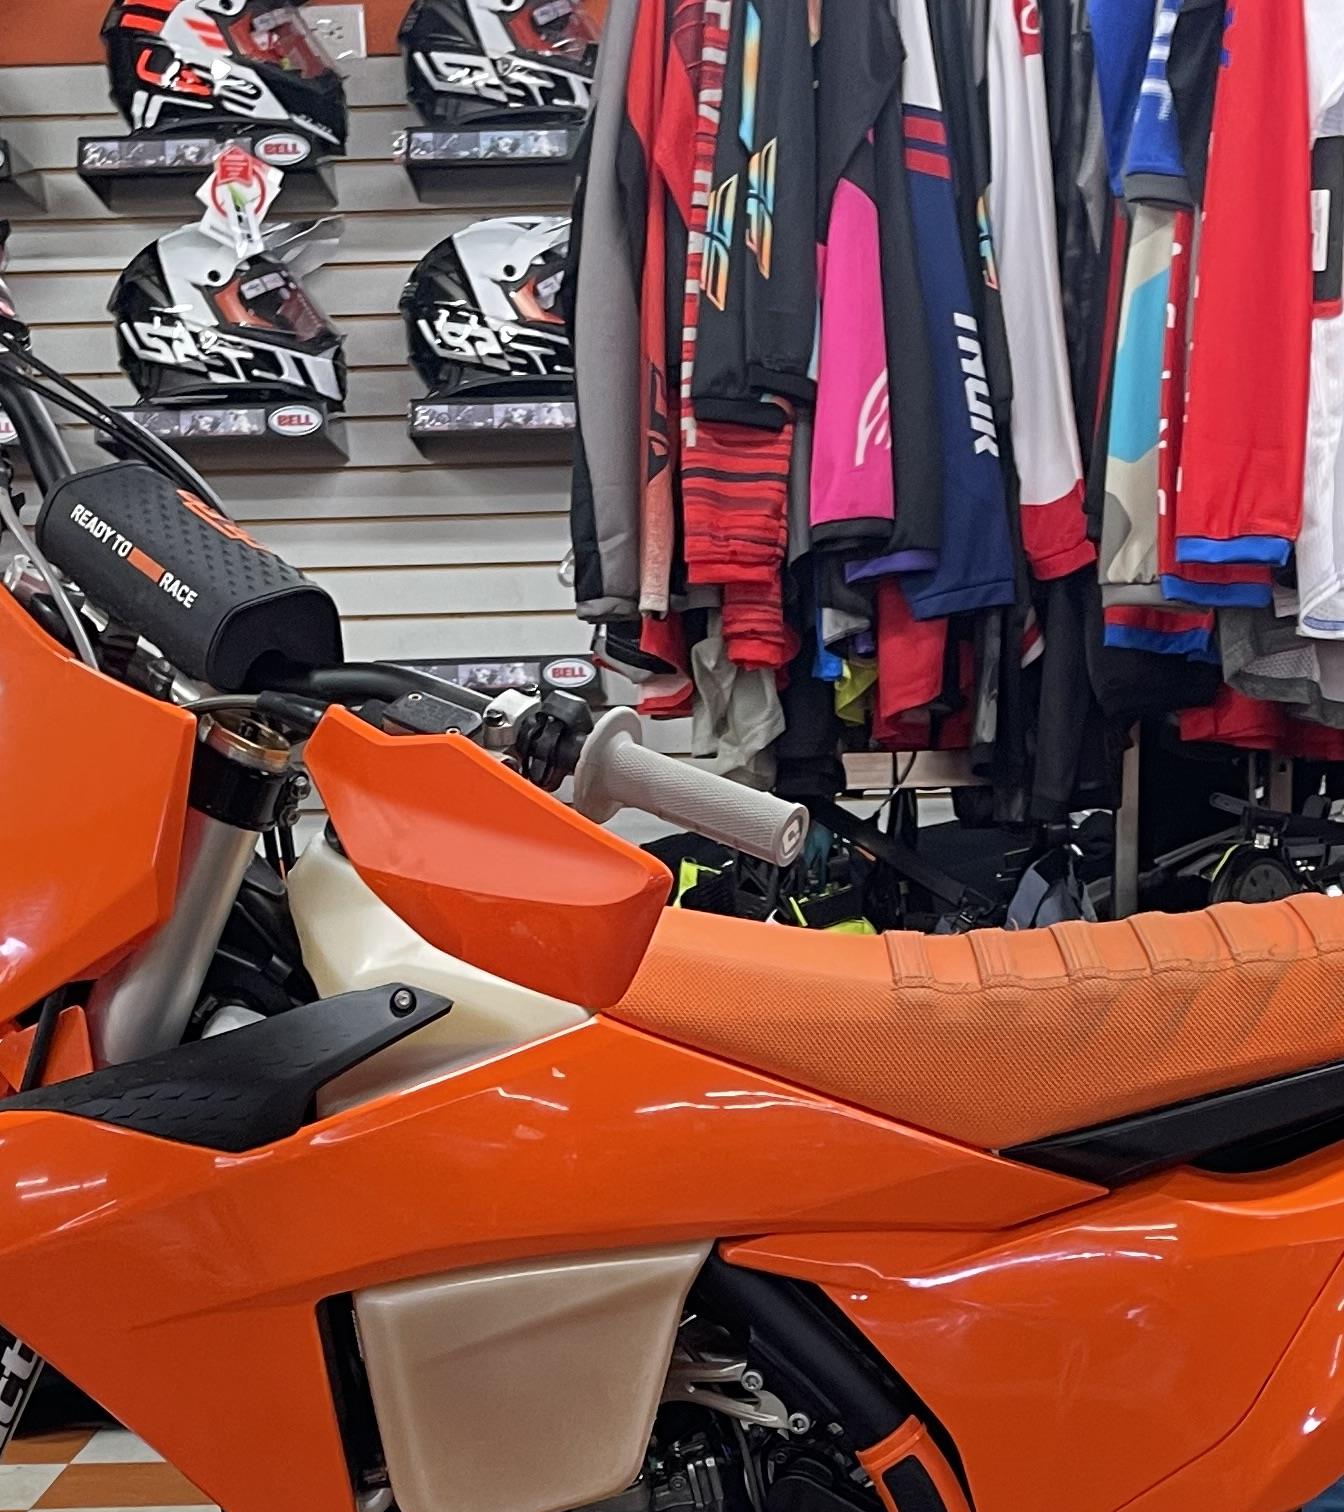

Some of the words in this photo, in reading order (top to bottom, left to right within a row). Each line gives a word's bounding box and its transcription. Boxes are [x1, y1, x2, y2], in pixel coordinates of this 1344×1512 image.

[263, 142, 301, 156] BELL
[277, 414, 313, 427] BELL
[70, 503, 116, 544] READY
[113, 533, 134, 558] TO
[158, 571, 199, 609] RACE
[549, 663, 588, 681] BELL
